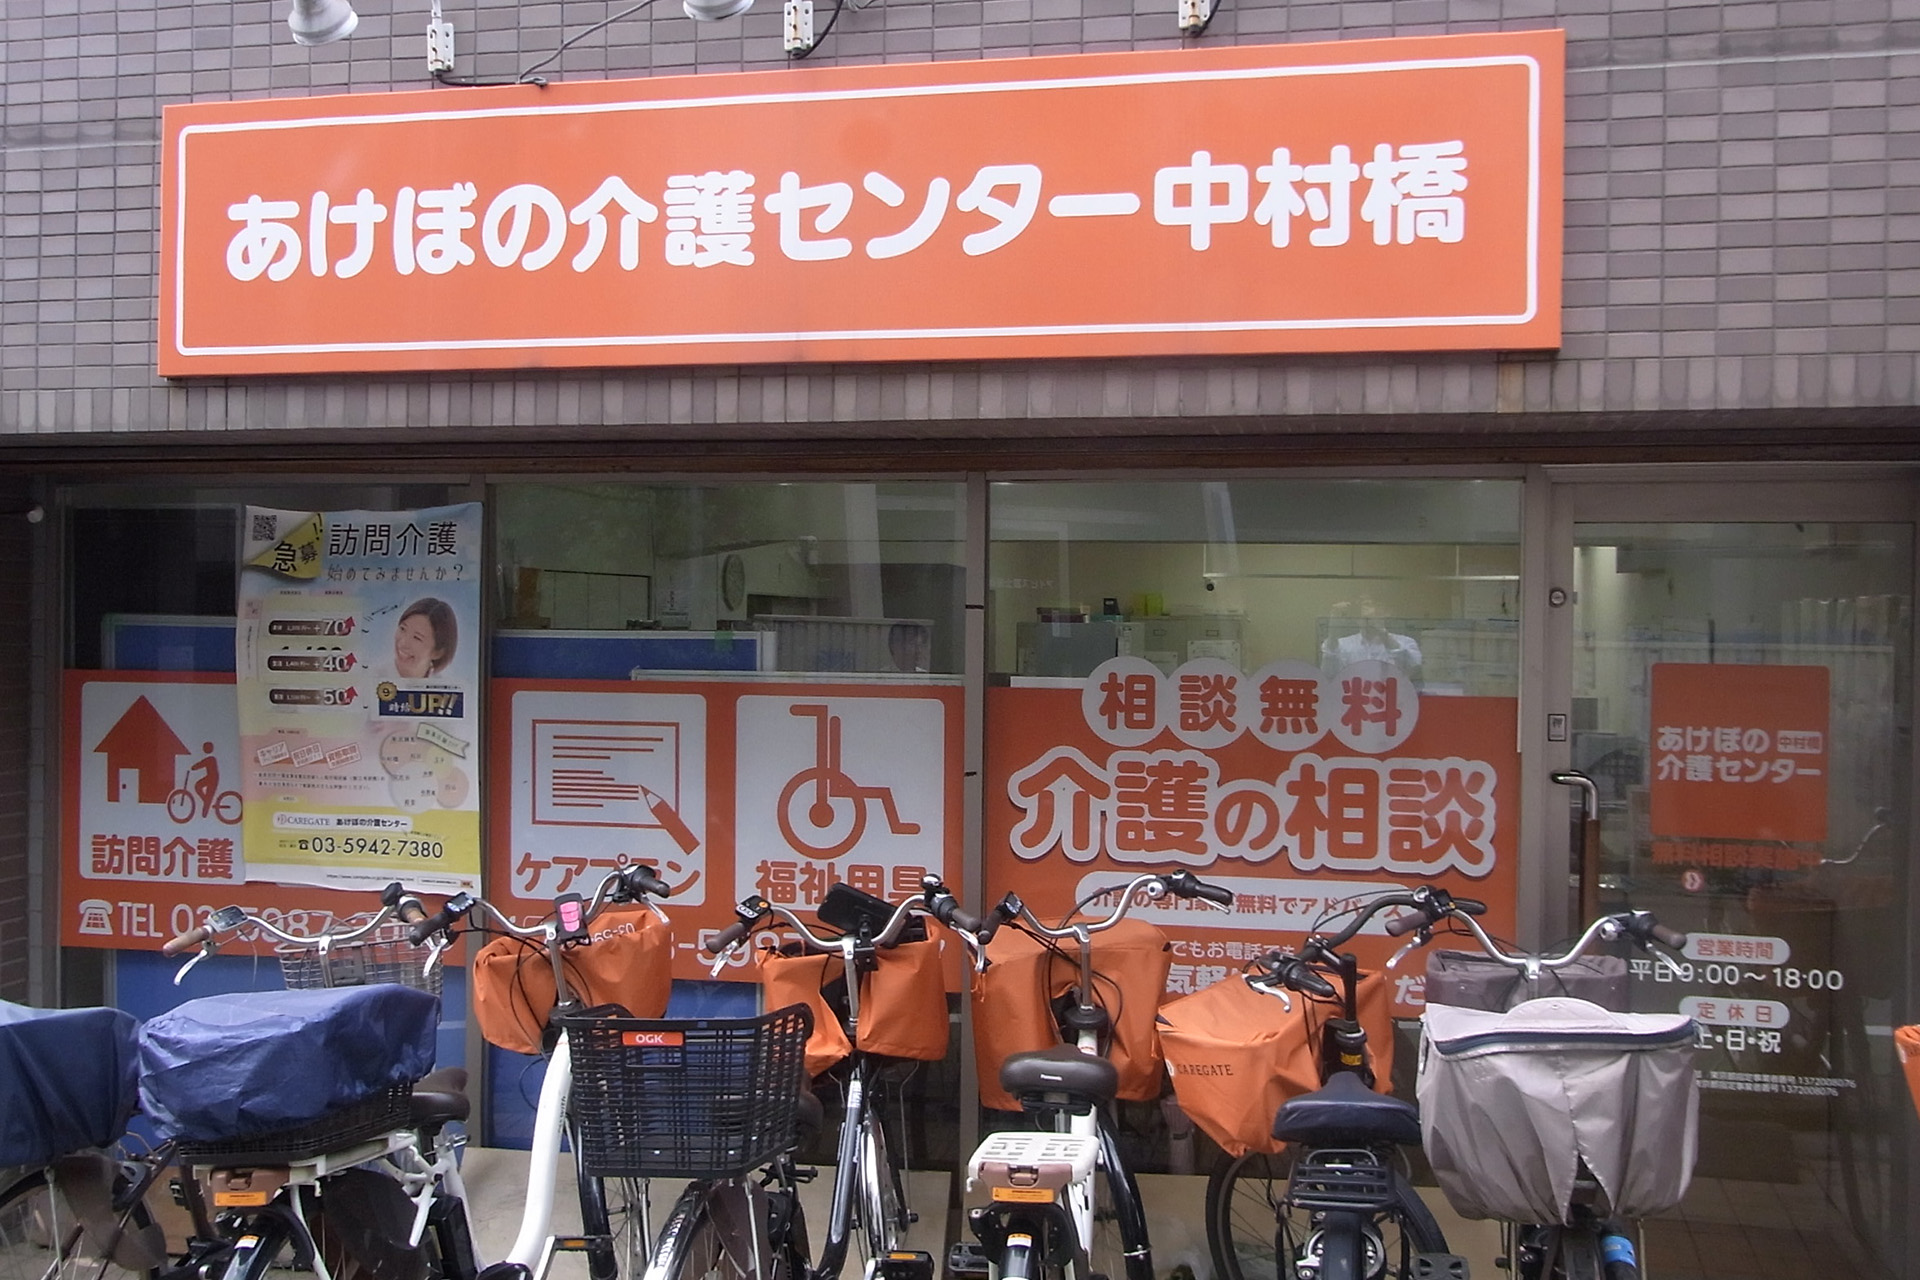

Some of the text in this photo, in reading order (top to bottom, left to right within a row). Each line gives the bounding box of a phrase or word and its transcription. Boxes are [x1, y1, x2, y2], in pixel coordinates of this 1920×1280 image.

[225, 140, 1470, 283] あけぼの介護センター中村橋
[328, 522, 457, 557] 訪問介護
[1098, 671, 1402, 737] 相談無料
[1656, 726, 1770, 754] あけぼの
[1656, 754, 1822, 784] 介護センター
[287, 816, 408, 827] CAREGATE あけぼの介護センター
[1014, 753, 1491, 869] 介護の相談
[91, 833, 234, 880] 訪問介護
[312, 836, 444, 859] 03-5942-7380
[118, 902, 164, 938] TEL
[1696, 939, 1774, 960] 営業時間
[1697, 1002, 1773, 1023] 定休日
[635, 1032, 664, 1044] OGK
[1177, 1064, 1233, 1076] CAREGATE
